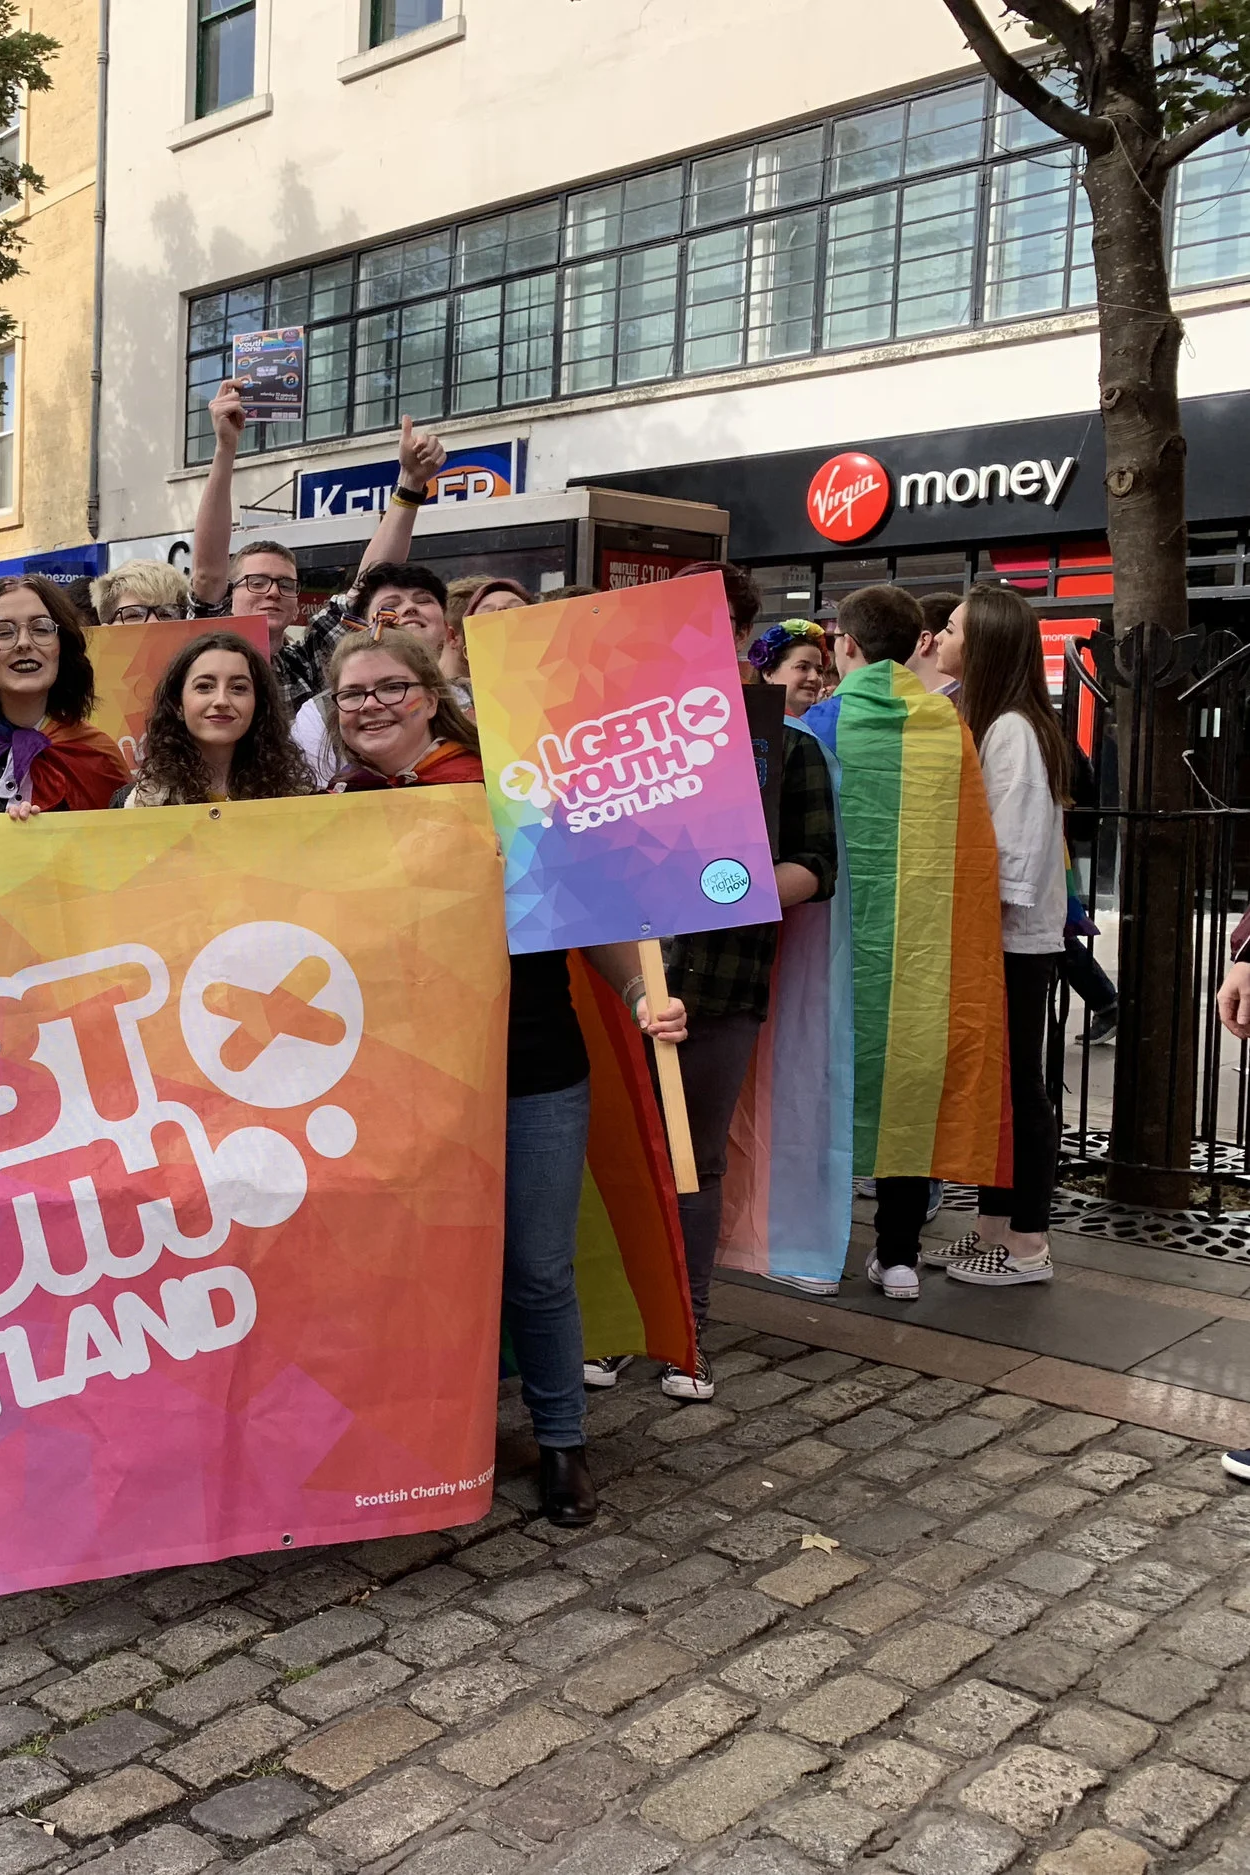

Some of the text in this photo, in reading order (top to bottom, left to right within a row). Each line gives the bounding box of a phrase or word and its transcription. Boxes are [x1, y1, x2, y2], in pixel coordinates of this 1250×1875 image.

[238, 338, 264, 349] youth
[813, 457, 1074, 527] Virgin money
[537, 696, 675, 775] LGBT
[548, 735, 692, 810] YOUTH
[567, 775, 702, 833] SCOTLAND
[703, 870, 728, 887] trans
[711, 873, 740, 893] rights
[727, 876, 748, 893] now
[354, 1488, 408, 1508] Scottish
[410, 1482, 456, 1496] Charity
[458, 1478, 477, 1492] No:
